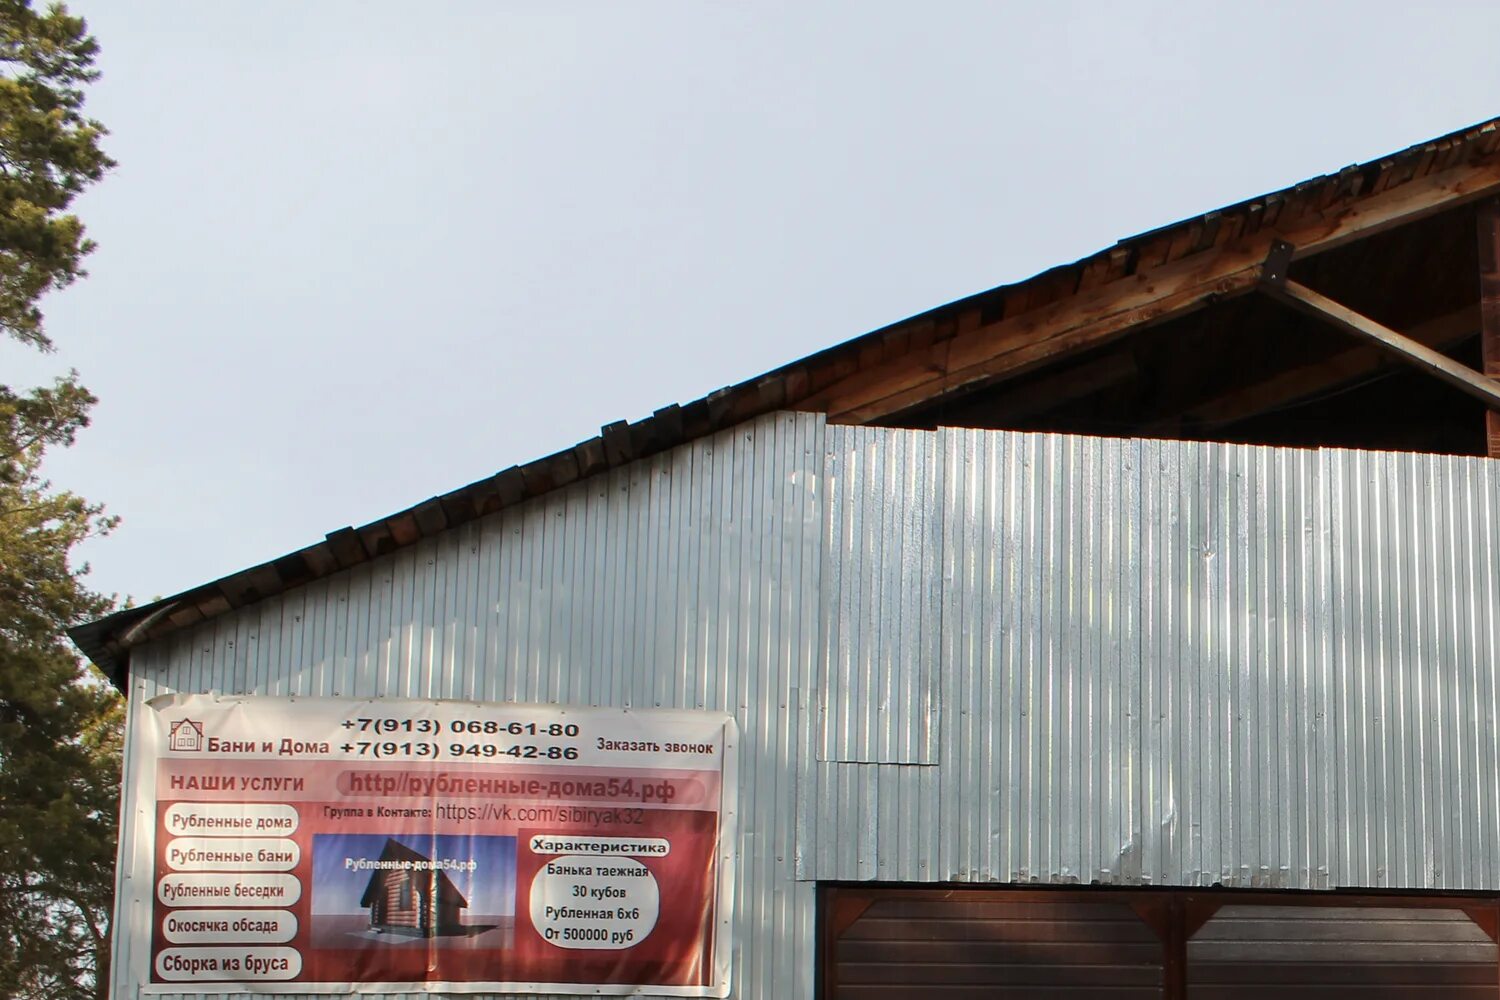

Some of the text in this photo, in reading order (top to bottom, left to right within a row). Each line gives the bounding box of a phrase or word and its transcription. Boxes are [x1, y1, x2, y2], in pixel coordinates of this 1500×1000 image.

[341, 719, 580, 737] +7(913) 068-61-80
[207, 738, 329, 756] Бани и Дома
[340, 742, 578, 760] +7(913) 949-42-86
[597, 737, 713, 754] Заказать звонок
[170, 775, 304, 792] НАШИ УСЛУГИ
[172, 813, 292, 830] Рубленные дома
[323, 803, 644, 827] Группа в Контакте: https://vk.com/sibiryak32
[533, 839, 667, 853] Характеристика
[171, 849, 293, 864] Рубленные бани
[345, 858, 477, 873] Рубленные-дома54.рф
[547, 863, 649, 877] Банька таежная
[164, 883, 284, 900] Рубленные беседки
[572, 885, 626, 900] 30 кубов
[545, 906, 613, 920] Рубленная
[168, 918, 278, 933] Окосячка обсада
[545, 928, 634, 944] От 500000 руб
[163, 955, 289, 974] Сборка из бруса
